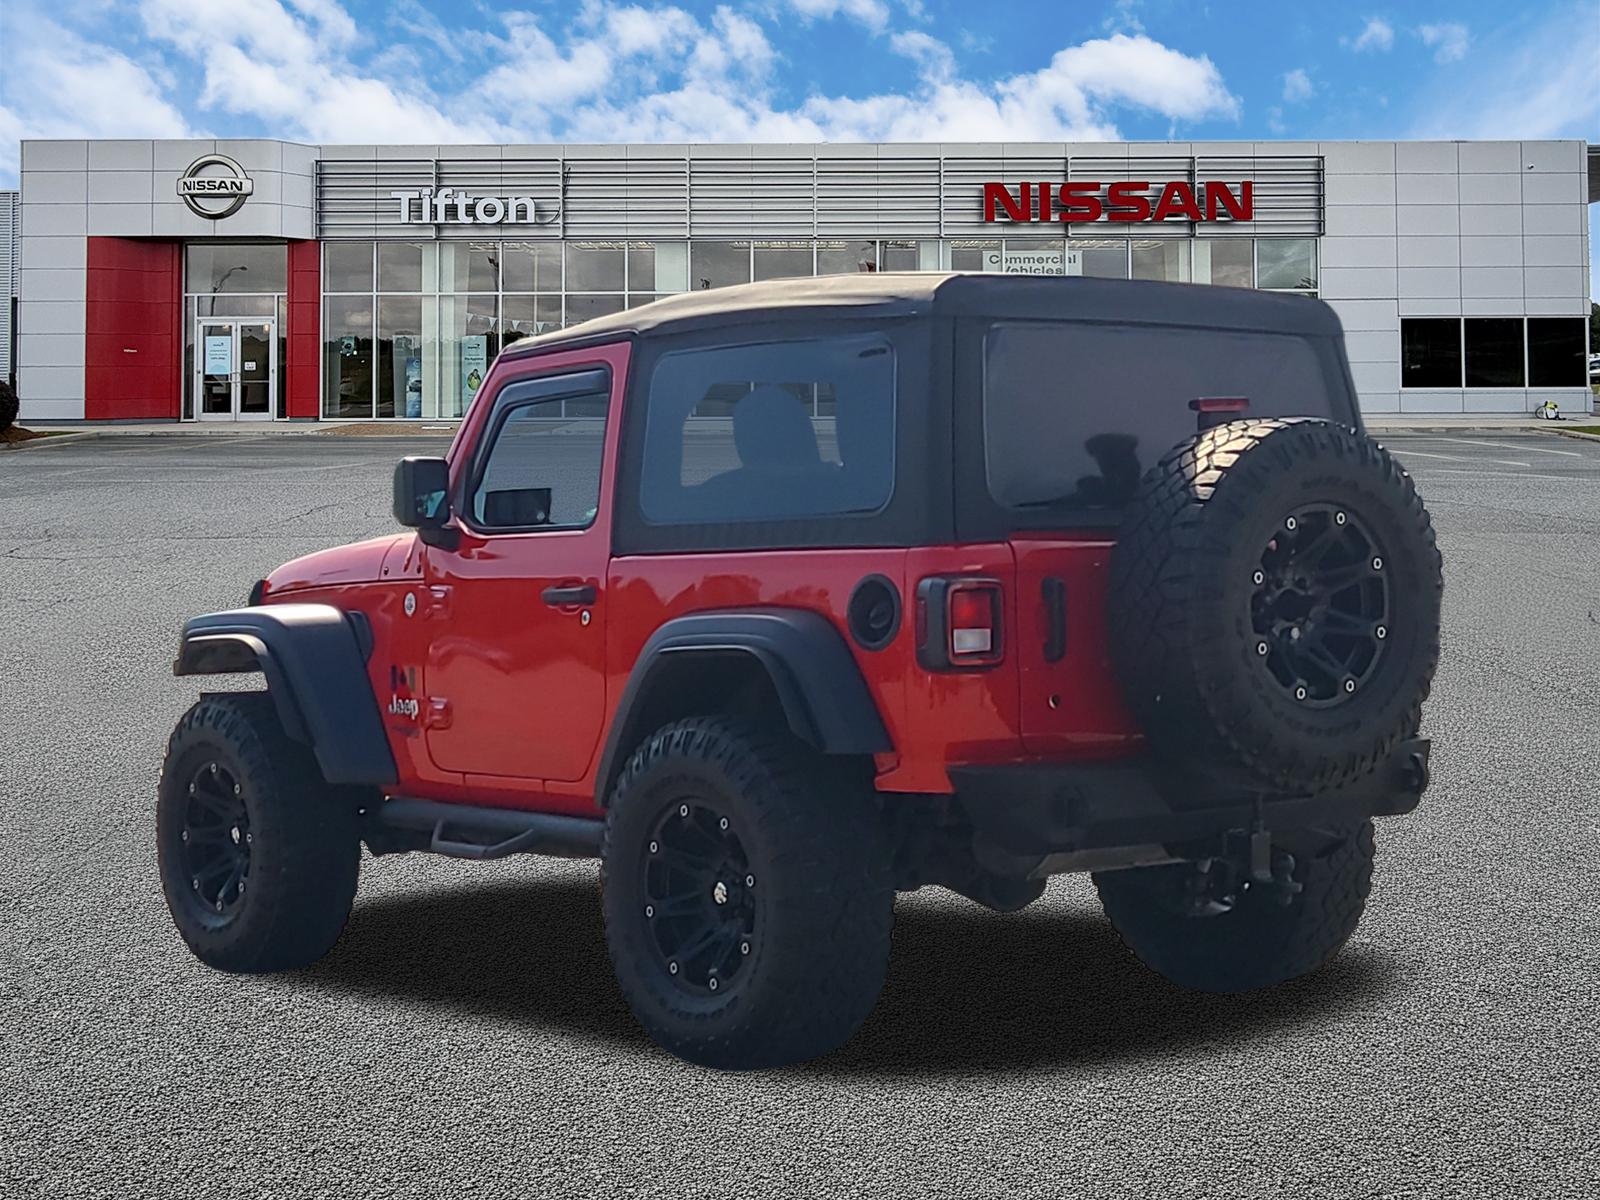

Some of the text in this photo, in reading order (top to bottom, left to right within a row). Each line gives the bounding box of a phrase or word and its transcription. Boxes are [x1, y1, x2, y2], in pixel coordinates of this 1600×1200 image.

[182, 180, 243, 191] NISSAN
[983, 181, 1253, 221] NISSAN
[390, 187, 536, 224] Tifton
[388, 694, 418, 720] Jeep
